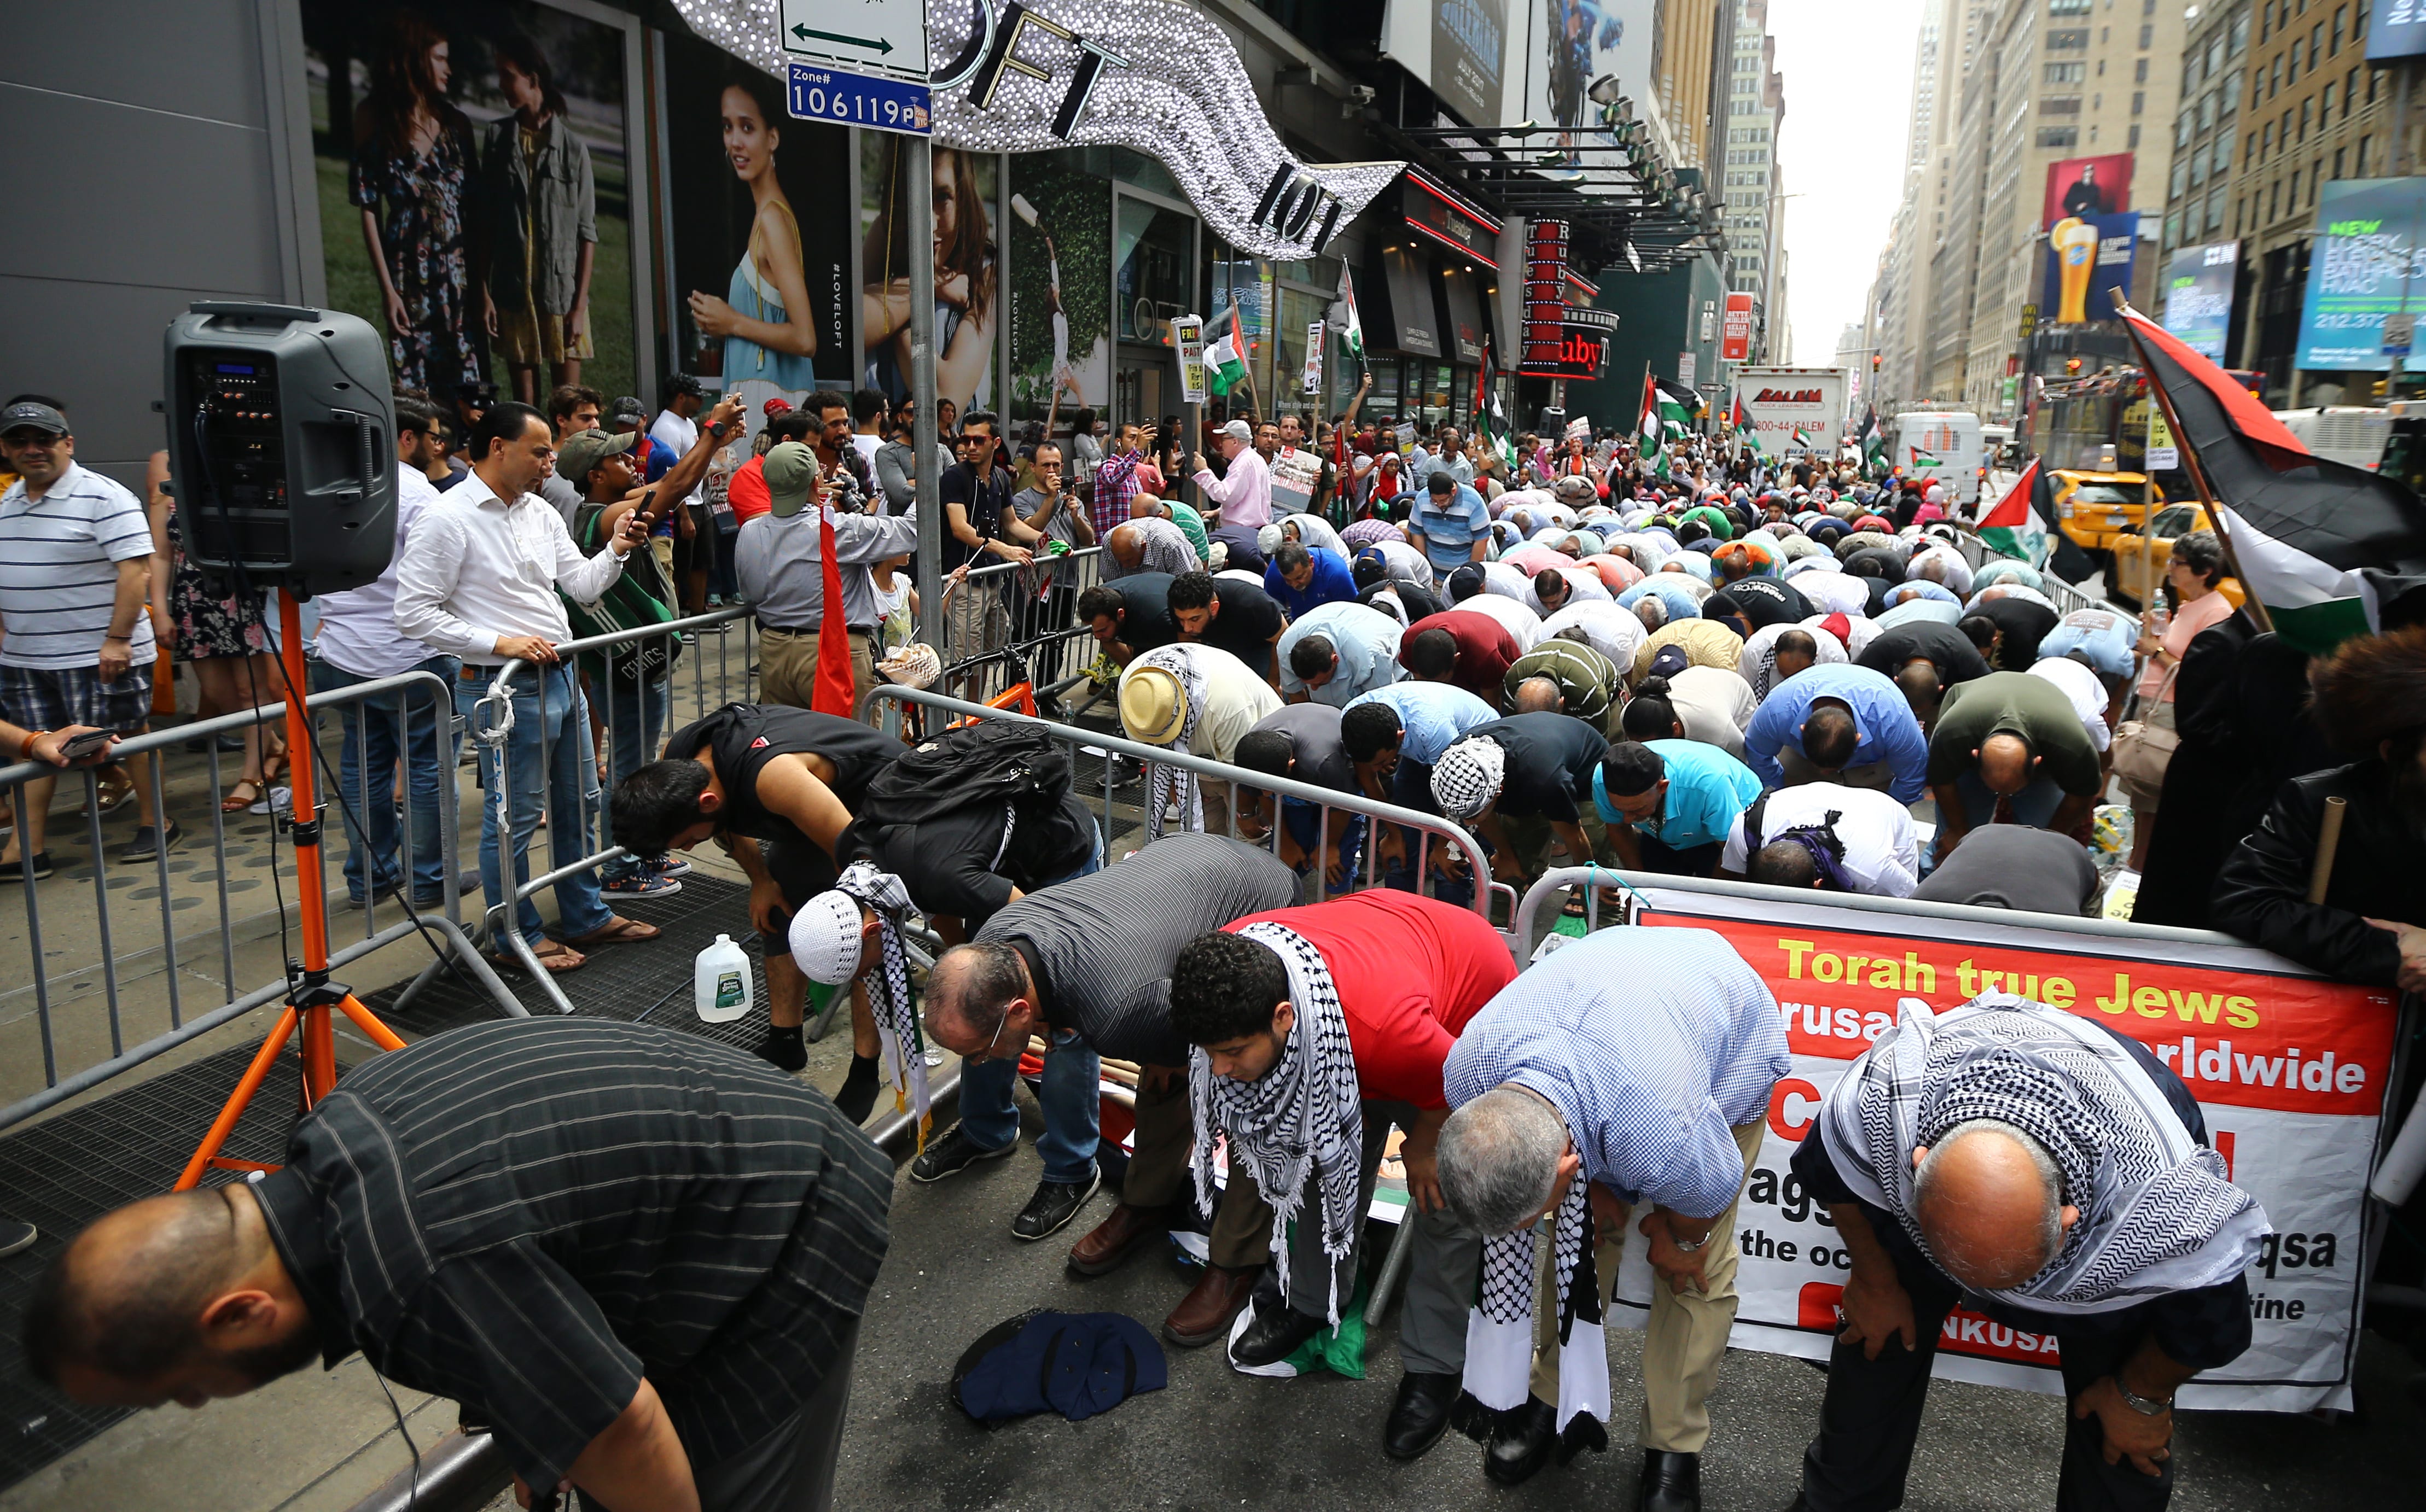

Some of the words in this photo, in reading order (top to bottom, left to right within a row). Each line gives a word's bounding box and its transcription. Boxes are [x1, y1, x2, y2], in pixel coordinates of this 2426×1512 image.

[793, 68, 831, 84] Zone#
[927, 0, 1129, 140] OFT
[794, 85, 899, 124] 106119
[916, 116, 928, 126] NYC
[1252, 162, 1353, 254] LOFT
[2328, 219, 2383, 237] NEW
[1556, 224, 1569, 300] Ruby
[833, 263, 842, 349] #LOVELOFT
[1522, 224, 1537, 358] Tuesday
[1560, 334, 1601, 372] uby
[1753, 388, 1822, 402] SALEM
[1778, 938, 1936, 994] Torah
[1956, 958, 2076, 1009] true
[2095, 973, 2260, 1029] Jews
[1781, 1001, 1899, 1042] rusa
[2149, 1035, 2365, 1094] rldwide
[1740, 1229, 1797, 1262] the
[2255, 1233, 2336, 1279] qsa
[2249, 1293, 2305, 1320] ine
[1943, 1316, 2060, 1355] NKUSA
